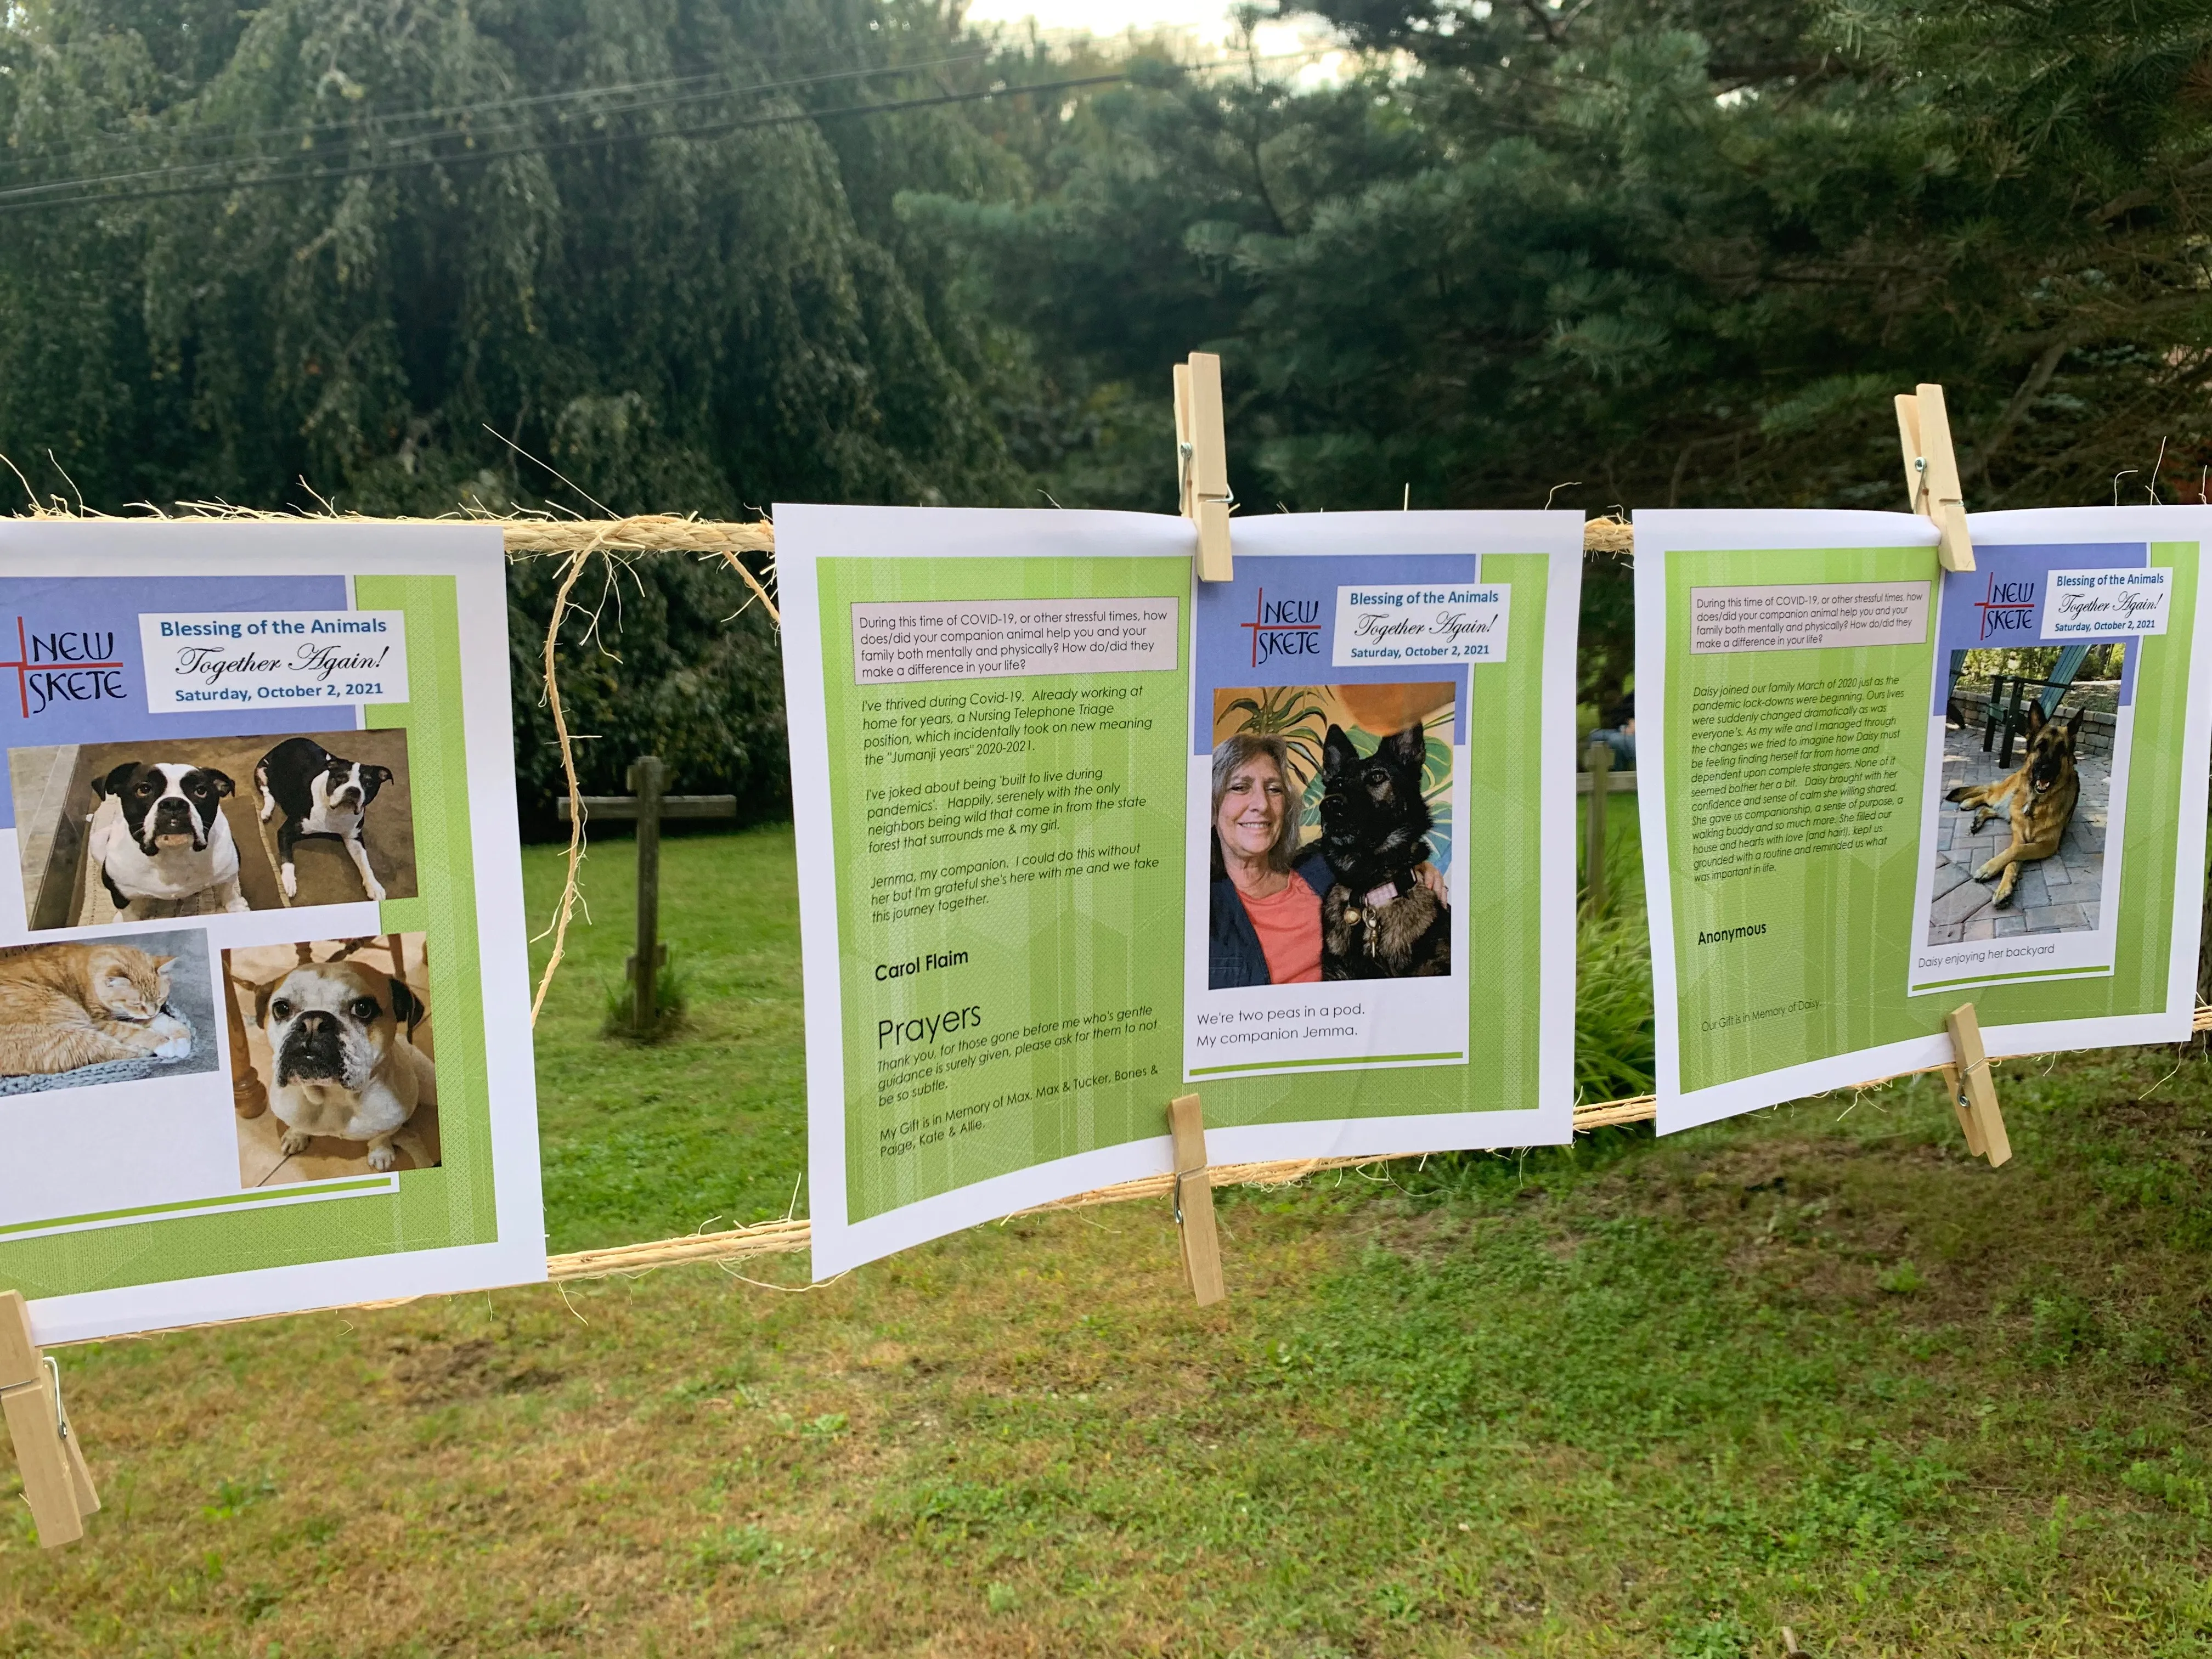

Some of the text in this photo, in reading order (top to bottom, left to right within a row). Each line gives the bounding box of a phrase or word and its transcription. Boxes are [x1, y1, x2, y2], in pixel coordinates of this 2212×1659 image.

[1992, 583, 2035, 602] NEW
[2057, 573, 2164, 588] Blessing of the Animals
[1350, 590, 1499, 608] Blessing of the Animals
[1696, 590, 1922, 610] During this time of COVID-19, or other stressful times, how
[2058, 591, 2164, 620] Together Again!
[859, 607, 1166, 630] During this time of COVID-19, or other stressful times, how
[1264, 600, 1319, 624] NEW
[1984, 610, 2033, 638] SKETE
[161, 618, 387, 638] Blessing of the Animals
[860, 622, 1145, 646] does/did your companion animal help you and your
[1353, 611, 1499, 645] Together Again!
[2055, 623, 2092, 632] Saturday,
[2094, 622, 2126, 630] October
[2136, 620, 2155, 628] 2021
[33, 631, 115, 662] NEW
[861, 637, 1154, 663] family both mentally and physically? How do/did they
[1258, 632, 1320, 664] SKETE
[1351, 647, 1402, 660] Saturday,
[1404, 646, 1448, 658] October
[1464, 645, 1490, 656] 2021
[1696, 637, 1721, 648] make
[1731, 636, 1775, 647] difference
[1777, 634, 1785, 645] in
[1786, 636, 1804, 647] your
[1805, 633, 1822, 644] life?
[175, 642, 390, 686] Together Again!
[862, 656, 1025, 678] make a difference in your life?
[30, 671, 128, 714] SKETE
[175, 686, 252, 703] Saturday,
[257, 685, 321, 699] October
[346, 682, 383, 696] 2021
[861, 684, 1143, 712] I've thrived during Covid-19. Already working at
[1692, 674, 1899, 698] Daisy joined our family March of 2020 just as the
[862, 701, 1114, 730] home for years, a Nursing Telephone Triage
[863, 715, 1153, 752] position, which incidentally took on new meaning
[864, 737, 1034, 765] the "Jumanji years" 2020-2021.
[1693, 862, 1776, 882] was important in life.
[1698, 923, 1766, 946] Anonymous
[875, 948, 968, 980] Carol Flaim
[1917, 943, 2055, 968] Daisy enjoying her backyard
[1197, 1002, 1364, 1024] We're two peas in a pod.
[1701, 997, 1822, 1031] Our Gift is in Memory of Daisy.
[878, 1006, 980, 1050] Prayers
[1197, 1024, 1357, 1049] My companion Jemma.
[880, 1140, 915, 1158] Paige,
[919, 1129, 944, 1145] Kate
[949, 1124, 956, 1136] &
